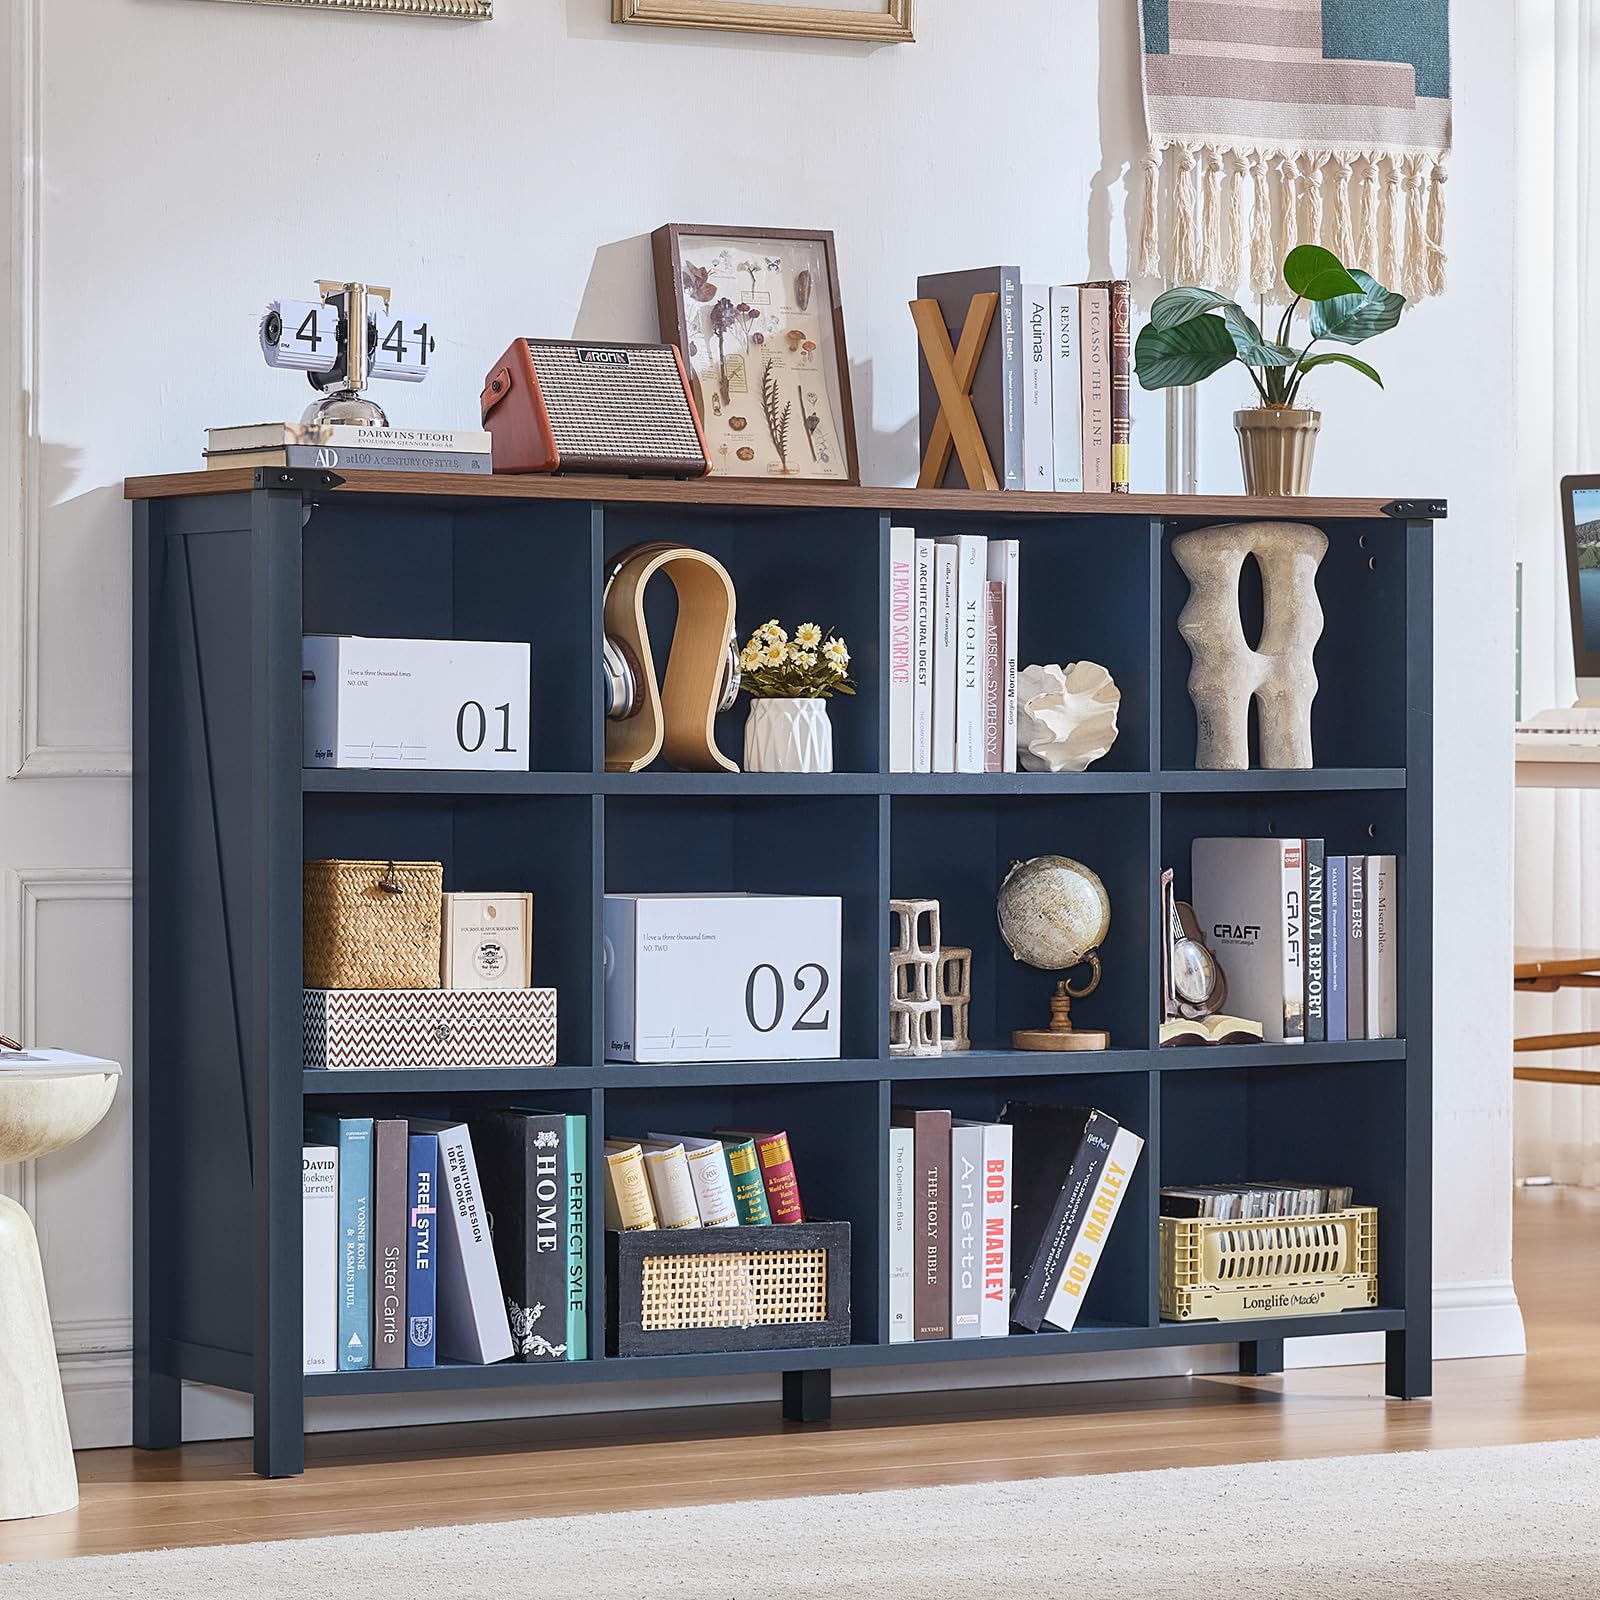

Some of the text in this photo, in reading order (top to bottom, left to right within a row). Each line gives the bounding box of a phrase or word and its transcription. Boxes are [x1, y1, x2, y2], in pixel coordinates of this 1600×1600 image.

[296, 310, 322, 352] 4
[382, 320, 428, 366] 41
[1004, 279, 1014, 360] all in good taste
[1030, 302, 1045, 362] Aquinas
[1060, 306, 1070, 359] RENOIR
[585, 351, 626, 363] AROMA
[1091, 302, 1102, 446] PICASSO THE LINE
[314, 448, 338, 468] AD
[381, 457, 420, 466] CENTURY
[358, 429, 454, 442] DARWINS TEORI
[892, 562, 910, 684] AL PACINO SCARFACE
[920, 562, 928, 646] ARCHITECTURAL
[918, 649, 927, 686] DIGEST
[966, 600, 976, 688] KINFOLK
[988, 625, 998, 667] MUSIC
[456, 700, 517, 752] 01
[988, 680, 998, 755] SYMPHONY
[1214, 924, 1261, 940] CRAFT
[1287, 891, 1299, 967] CRAFT
[1352, 866, 1362, 939] MILLERS
[1378, 872, 1386, 954] Les Miserables
[1309, 862, 1322, 1018] ANNUAL REPORT
[745, 963, 830, 1032] 02
[611, 1040, 623, 1051] Enjoy
[303, 1159, 334, 1170] DAVID
[448, 1147, 468, 1217] IDEA BOOK08
[456, 1144, 482, 1243] FURNITURE DESIGN
[627, 1173, 639, 1184] RW
[705, 1168, 718, 1178] RW
[1070, 1180, 1082, 1204] THEN
[415, 1172, 430, 1270] FREE STYLE
[536, 1154, 557, 1253] HOME
[928, 1167, 938, 1285] THE HOLY BIBLE
[985, 1159, 1004, 1302] BOB MARLEY
[1057, 1210, 1071, 1236] WANT
[1062, 1251, 1093, 1298] BOB
[1084, 1160, 1127, 1244] MARLEY
[346, 1228, 354, 1308] & RASMUS JUUL
[357, 1243, 366, 1270] KONÉ
[570, 1173, 582, 1311] PERFECT SYLE
[1048, 1259, 1058, 1274] AN
[1054, 1236, 1062, 1247] TO
[1055, 1224, 1072, 1259] RAISING
[383, 1247, 399, 1344] Sister Carrie
[1243, 1295, 1289, 1310] Longlife
